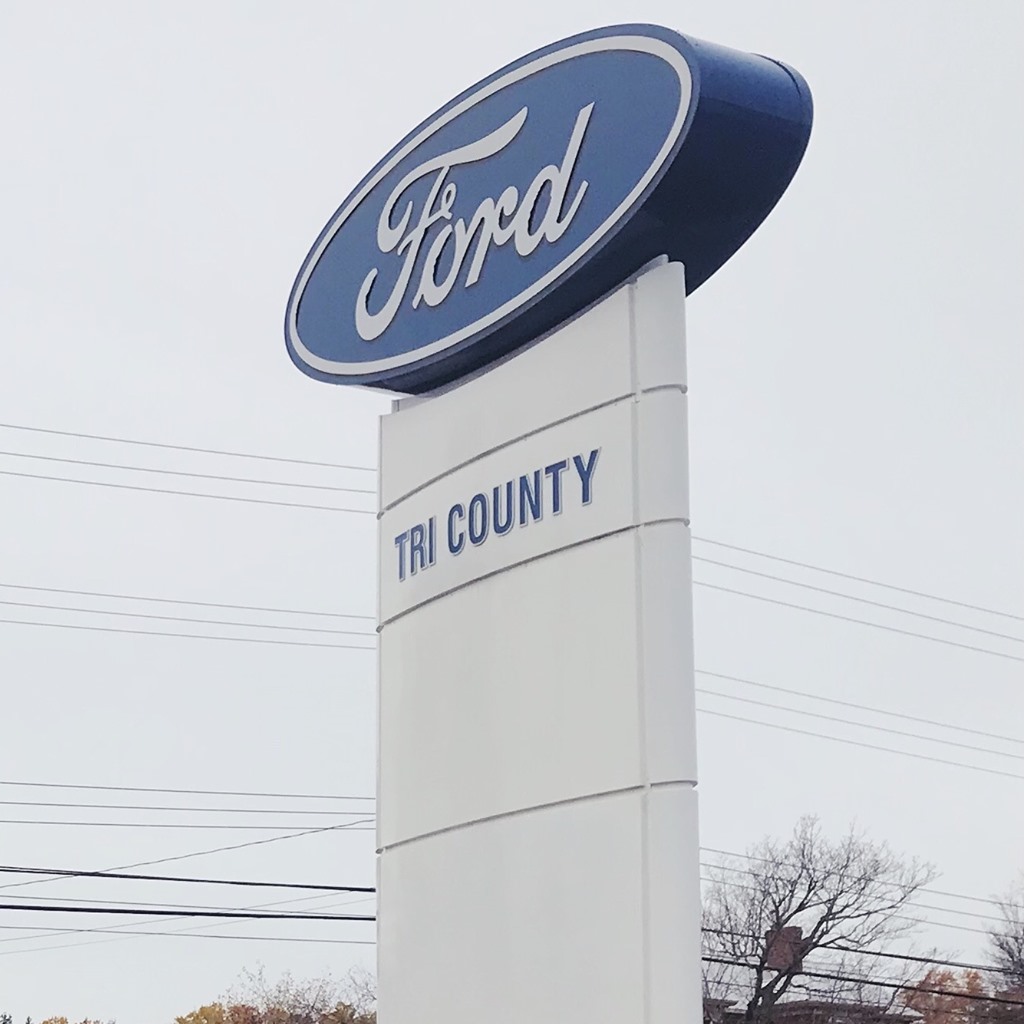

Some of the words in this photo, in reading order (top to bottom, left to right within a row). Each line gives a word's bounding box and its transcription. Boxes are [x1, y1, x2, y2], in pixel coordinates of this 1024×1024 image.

[355, 102, 595, 341] Ford
[394, 517, 436, 582] TRI
[448, 447, 602, 557] COUNTY
